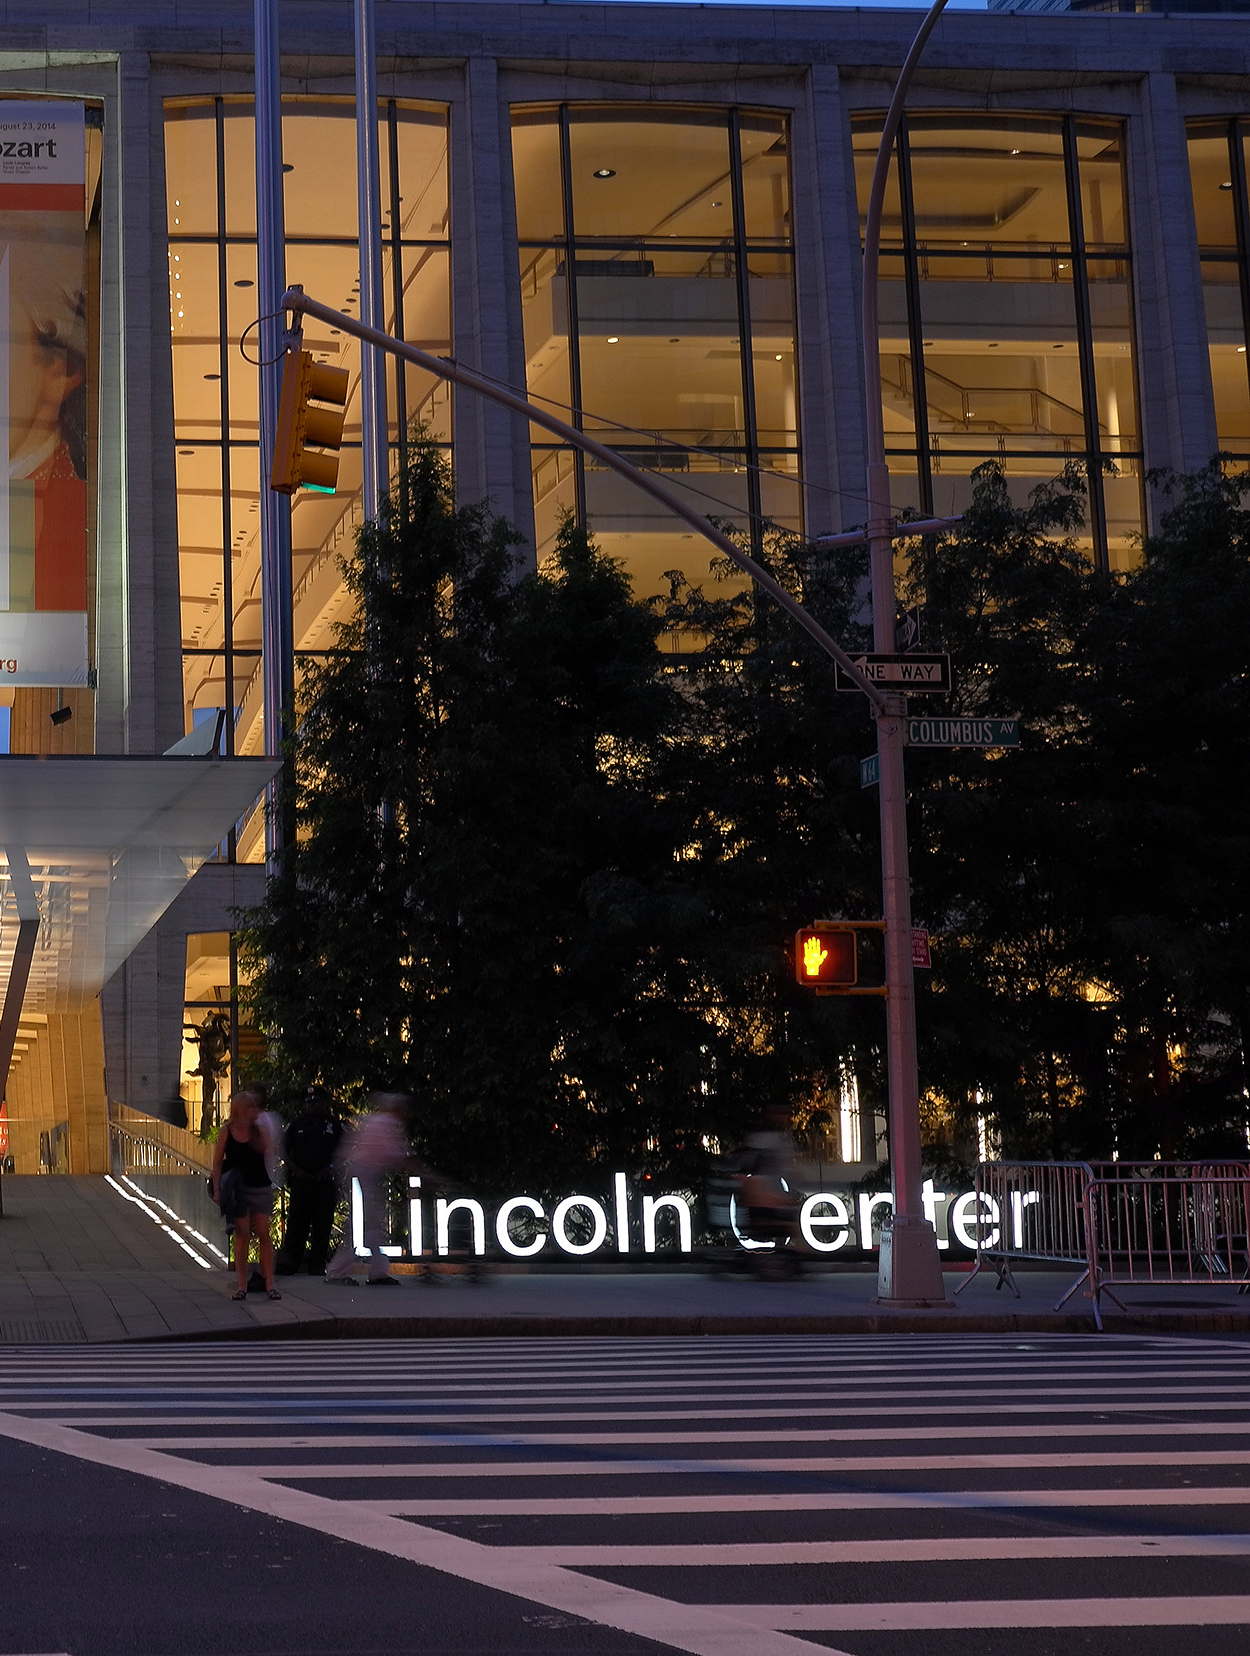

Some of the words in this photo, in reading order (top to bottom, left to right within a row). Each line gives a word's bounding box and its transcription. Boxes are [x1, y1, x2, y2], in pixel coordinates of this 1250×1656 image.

[37, 123, 57, 131] 2014
[900, 665, 934, 680] WAY
[909, 720, 994, 744] COLUMBUS
[1000, 722, 1015, 734] AV
[351, 1171, 693, 1257] Lincoln
